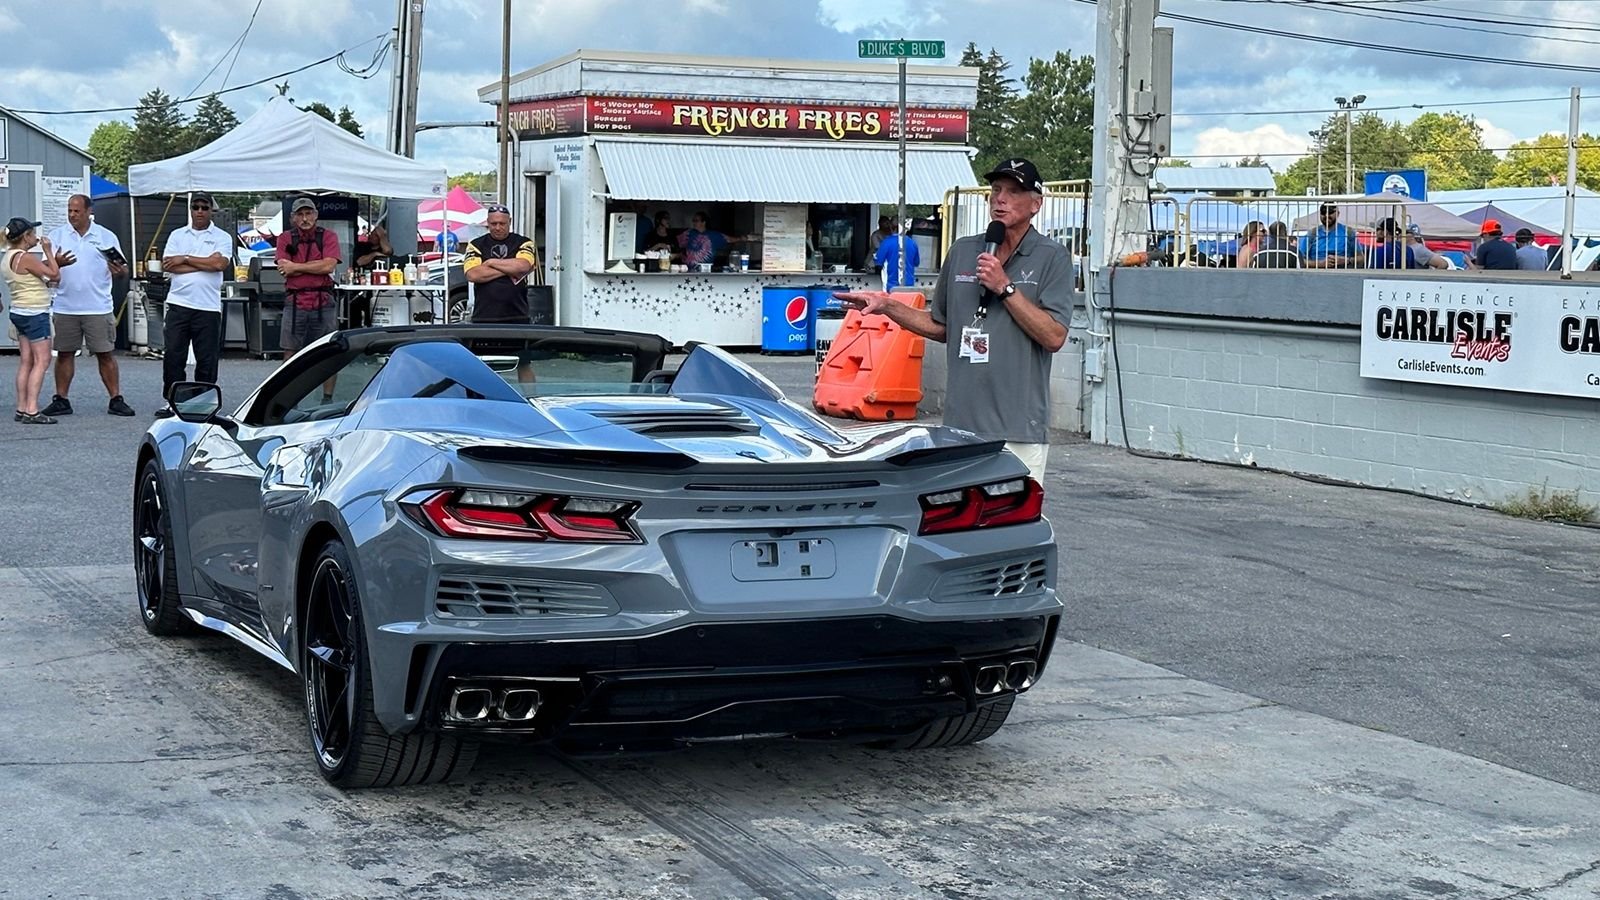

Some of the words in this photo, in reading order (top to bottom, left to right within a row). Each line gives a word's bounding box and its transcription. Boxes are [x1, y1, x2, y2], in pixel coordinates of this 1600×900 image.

[911, 42, 938, 55] BLVD
[633, 108, 662, 116] SAUSAGE
[937, 112, 963, 120] SAUSAGE
[508, 110, 529, 130] ENCH
[531, 108, 556, 135] FRIES
[672, 104, 789, 136] FRENCH
[798, 109, 881, 139] FRIES
[322, 201, 348, 212] pepsi
[1378, 291, 1514, 307] EXPERIENCE
[1376, 305, 1513, 345] CARLISLE
[1451, 332, 1511, 362] Events
[1397, 358, 1484, 376] CarlisleEvents.com
[696, 500, 878, 513] CORVETTE
